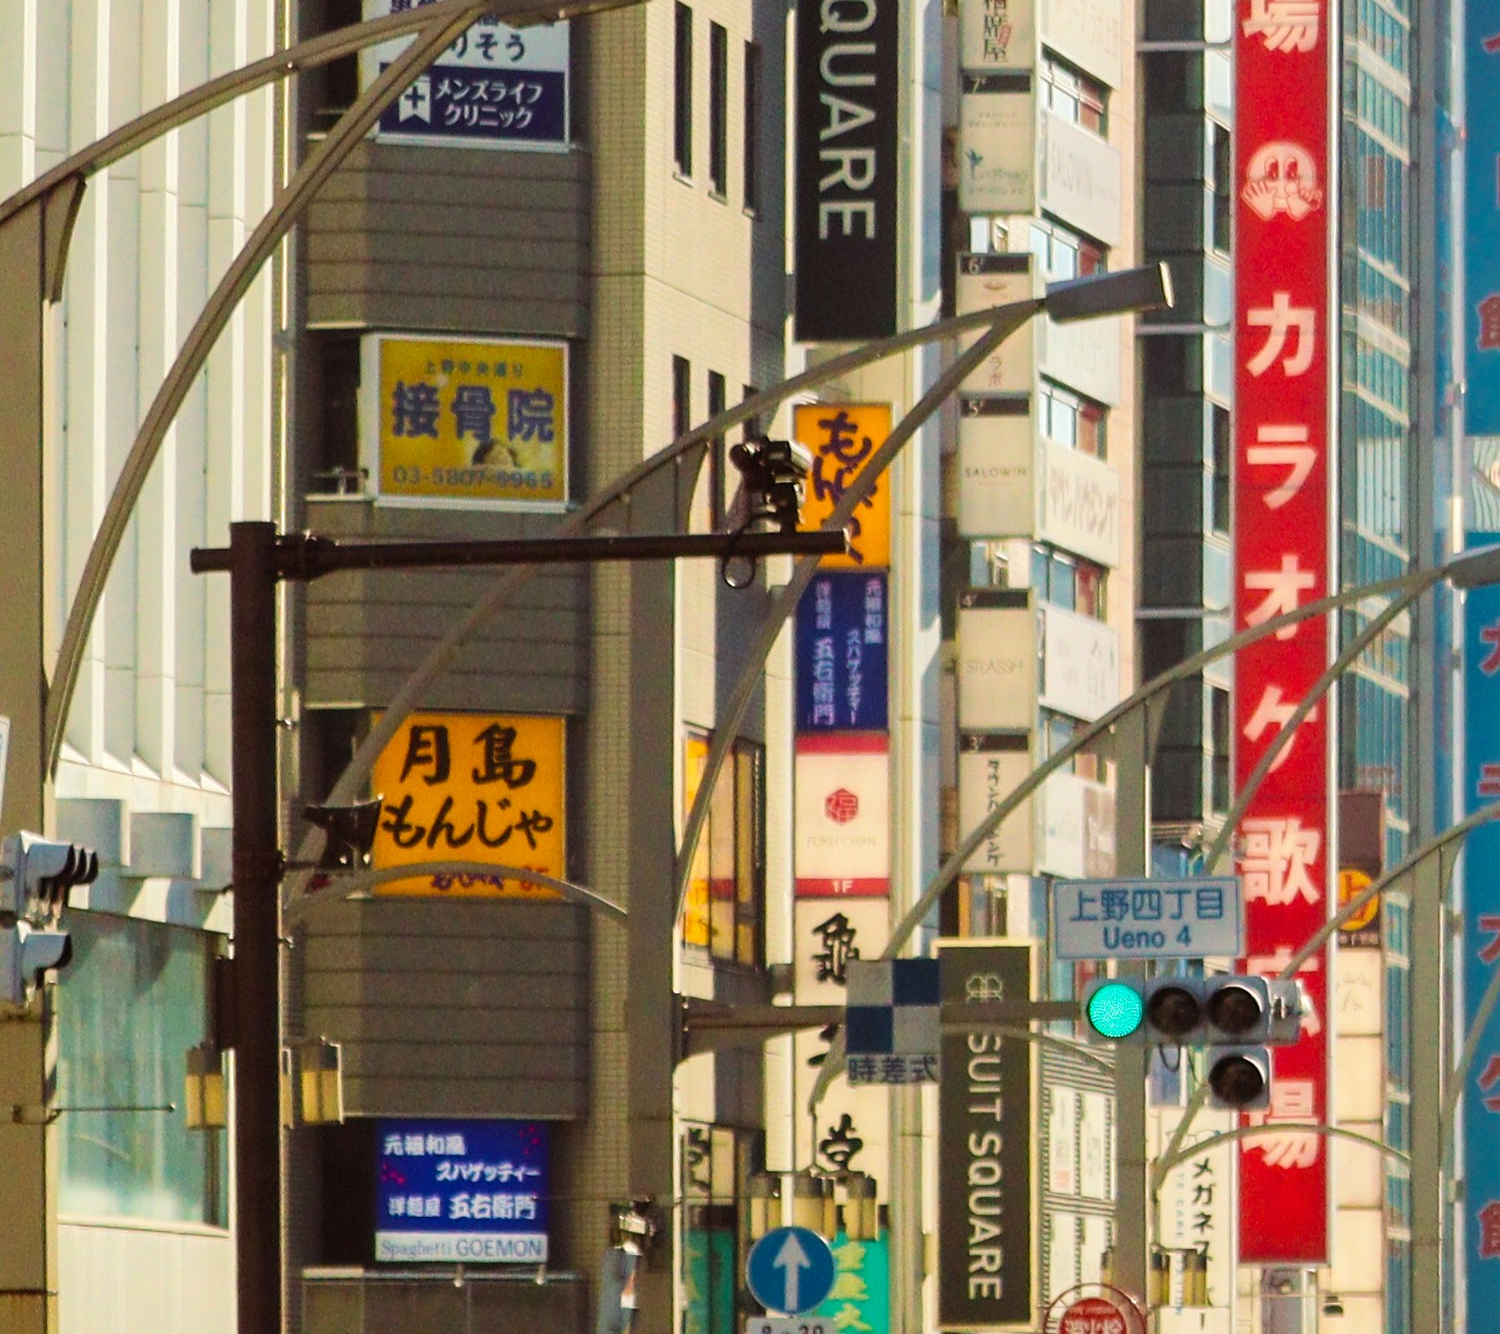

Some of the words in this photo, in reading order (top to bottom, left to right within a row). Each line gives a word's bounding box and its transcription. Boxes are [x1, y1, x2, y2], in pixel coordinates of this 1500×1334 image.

[429, 77, 543, 109] メンズライフ
[437, 104, 534, 130] クリニック
[391, 381, 556, 444] 接骨院
[399, 724, 536, 787] 月島
[382, 796, 553, 850] もんじゃ
[832, 880, 854, 894] 1F
[1069, 887, 1225, 923] 上野四丁目
[1103, 925, 1166, 950] Ueno
[1175, 924, 1193, 948] 4
[848, 1054, 940, 1085] 時差式
[966, 1028, 1003, 1123] SUIT
[449, 1194, 536, 1221] 五右衛門
[966, 1134, 1003, 1300] SQUARE
[455, 1238, 543, 1258] GOEMON
